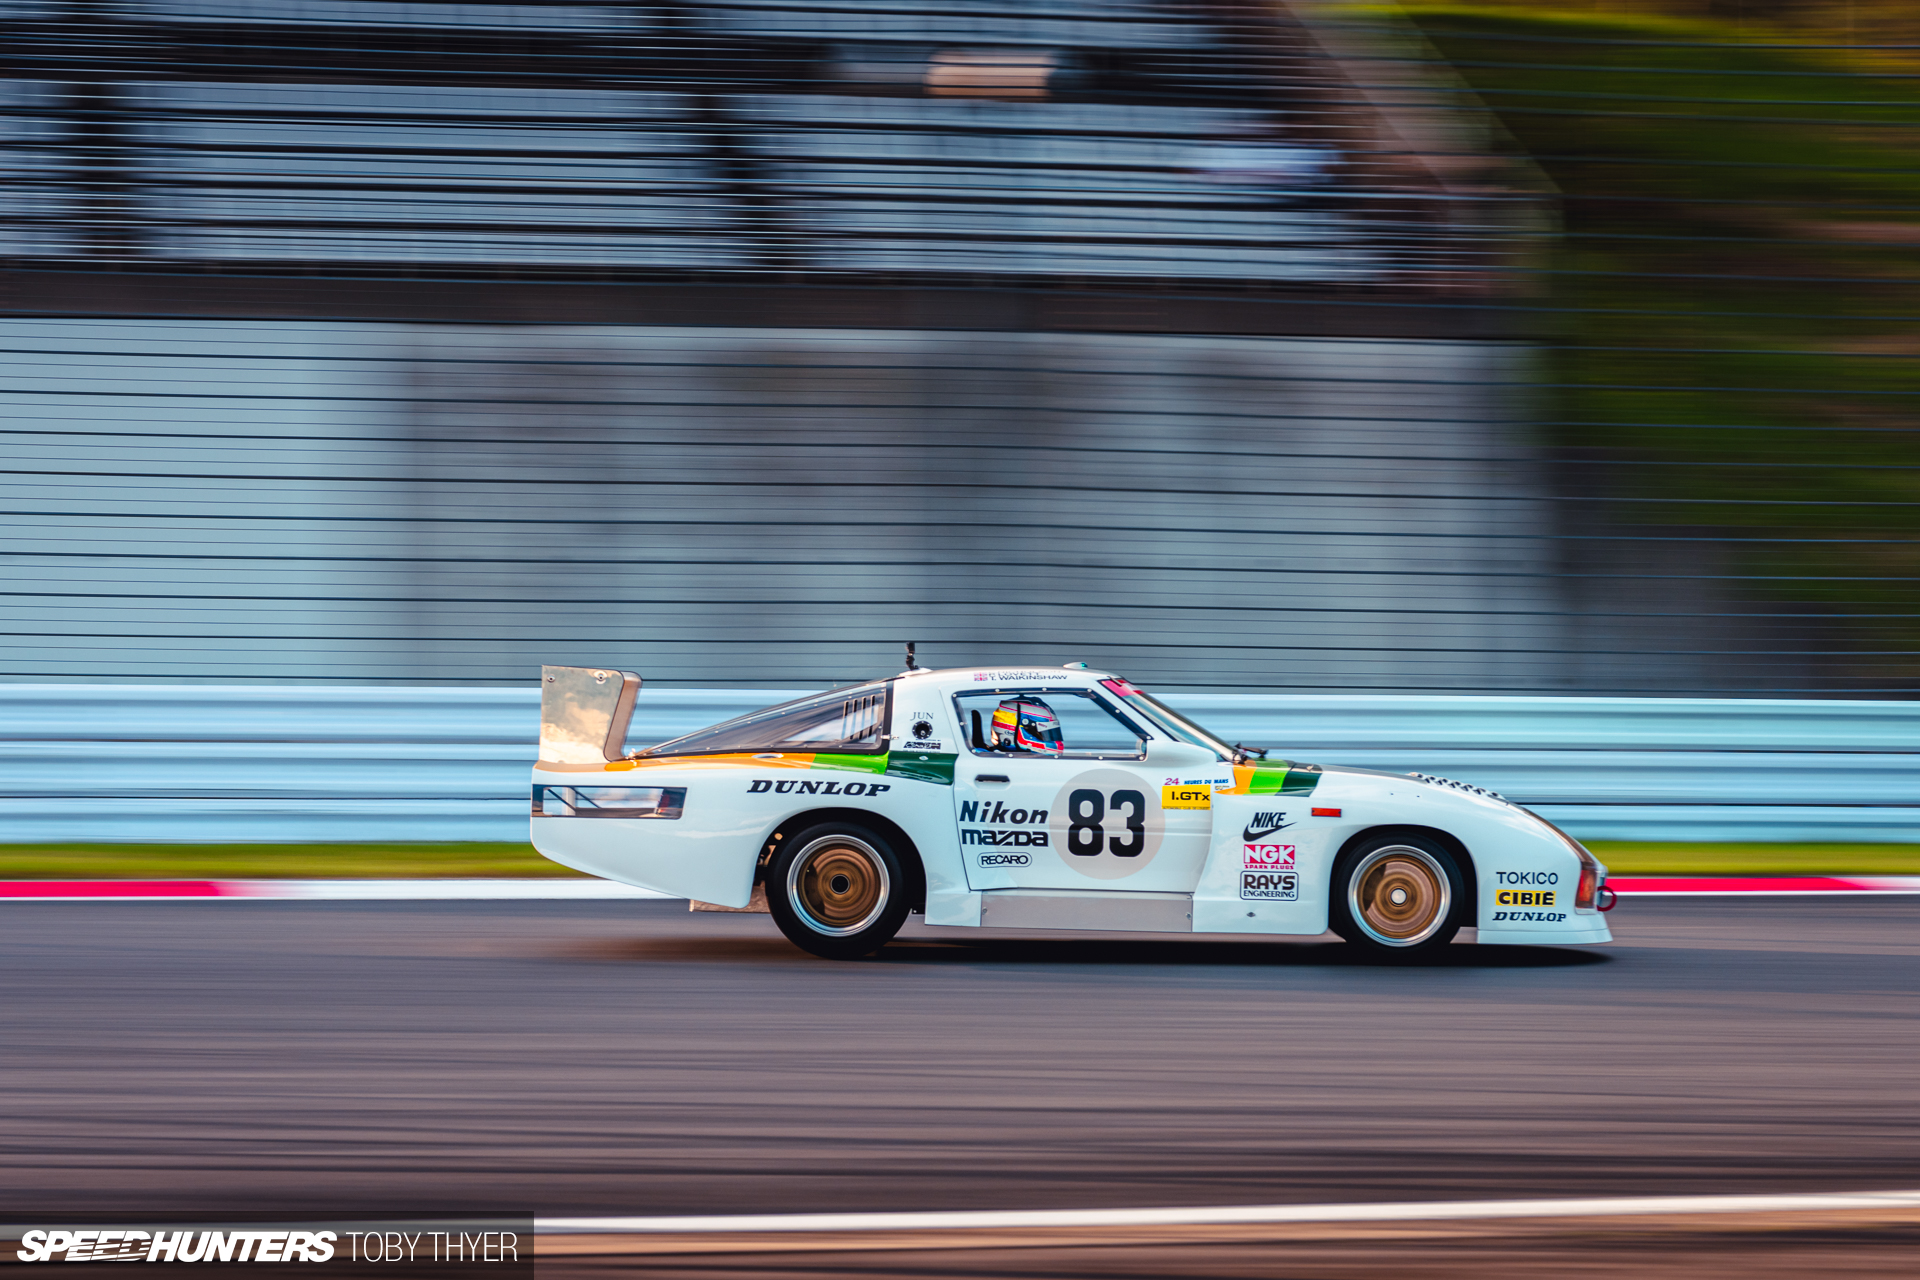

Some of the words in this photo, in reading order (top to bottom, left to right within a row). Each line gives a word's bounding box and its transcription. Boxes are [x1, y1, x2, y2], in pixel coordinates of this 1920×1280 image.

[910, 711, 934, 721] JUN
[746, 779, 891, 797] DUNLOP
[1164, 777, 1180, 786] 24
[959, 800, 1049, 824] Nikon
[1068, 788, 1146, 857] 83
[1250, 812, 1287, 828] NIKE
[980, 854, 1029, 866] RECARO
[1244, 845, 1295, 864] NGK
[1243, 874, 1296, 890] RAYS
[1496, 871, 1559, 885] TOKICO
[1243, 889, 1295, 898] ENGINEERING
[1492, 911, 1567, 922] DUNLOP
